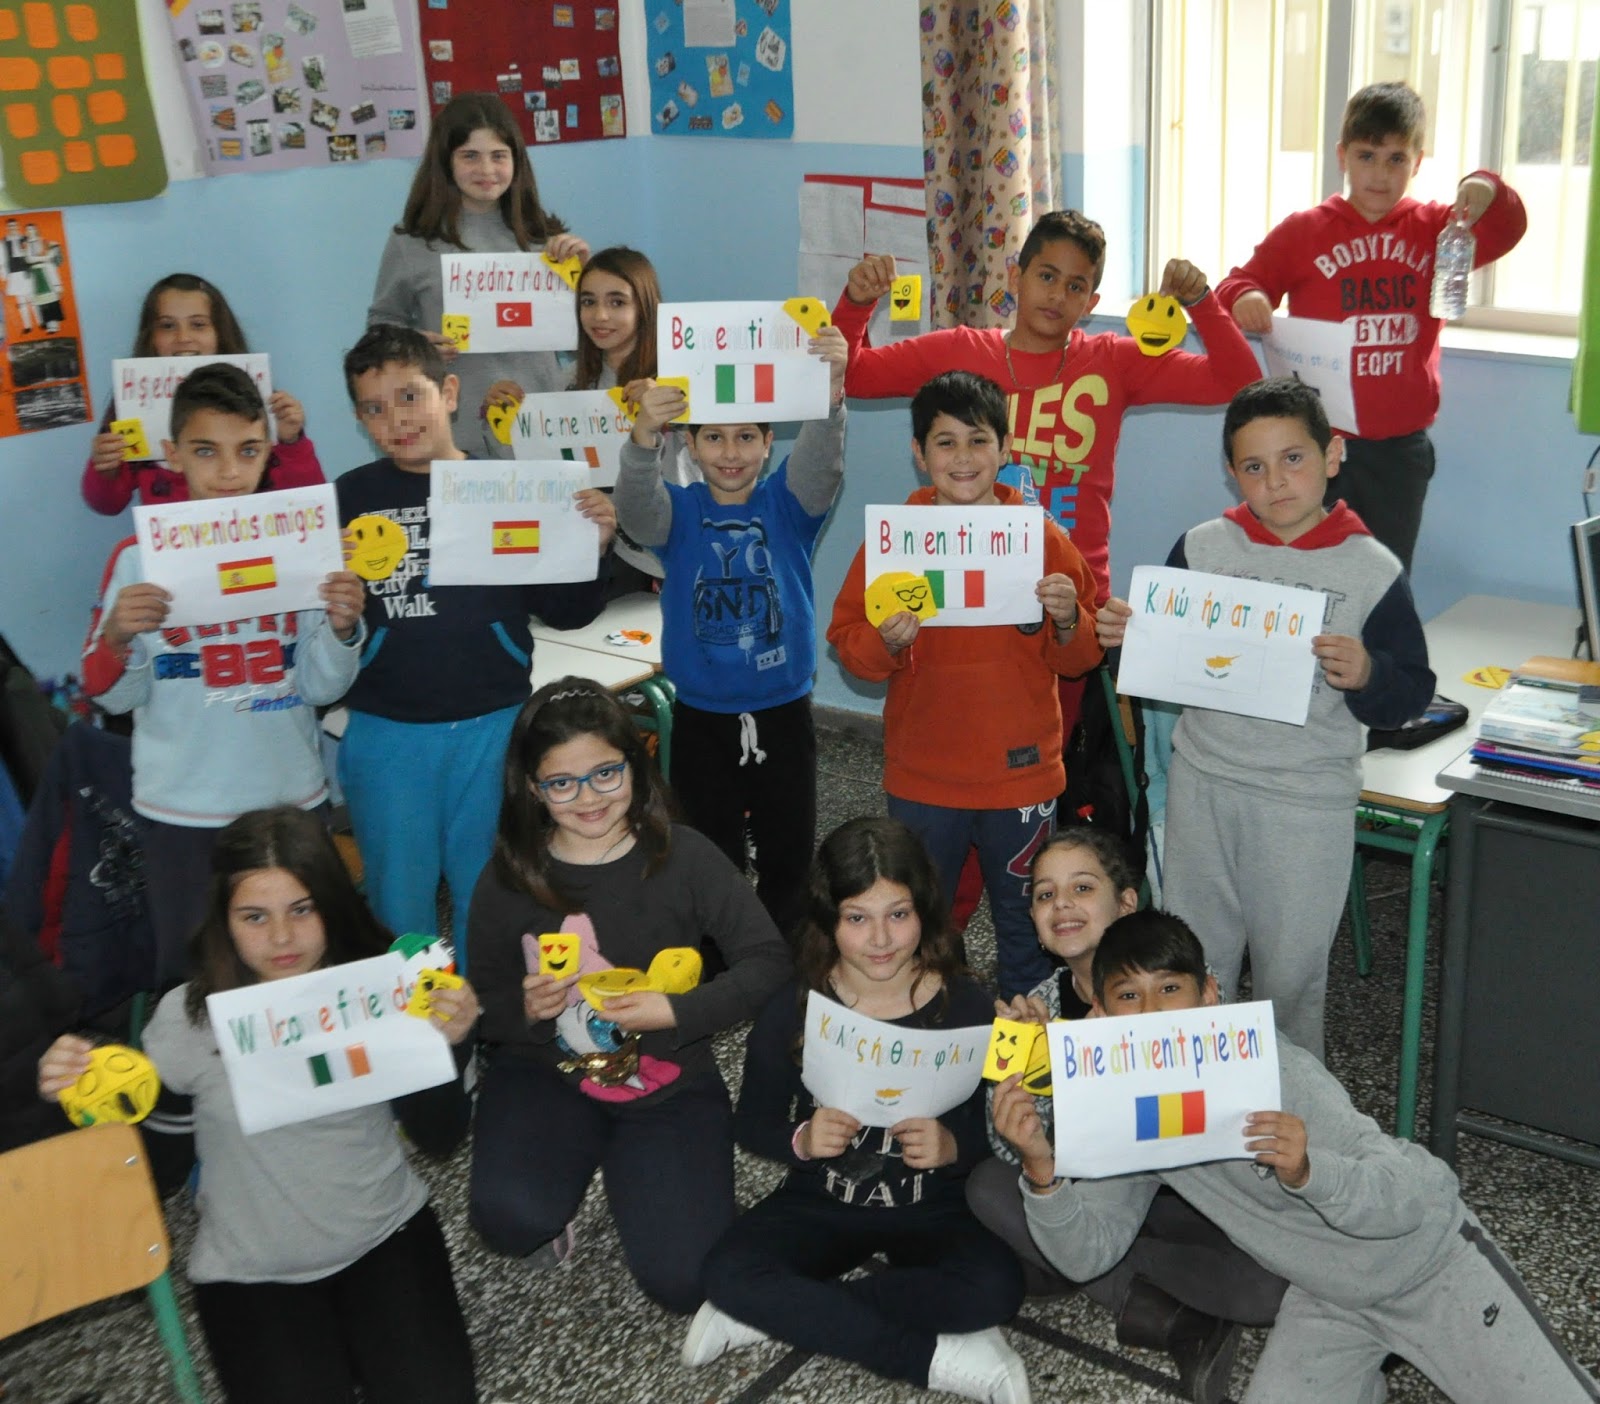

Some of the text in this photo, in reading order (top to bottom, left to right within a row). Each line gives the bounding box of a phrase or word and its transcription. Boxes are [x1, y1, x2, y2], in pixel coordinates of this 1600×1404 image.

[1313, 232, 1432, 279] BODYTALK
[1341, 274, 1416, 311] BASIC
[1356, 318, 1407, 343] GYM
[1357, 351, 1404, 376] EQPT
[149, 501, 324, 551] Bienvenidos amigos
[382, 593, 438, 619] Walk
[200, 639, 285, 688] 82
[1064, 1017, 1264, 1079] Bine ati venit prieteni
